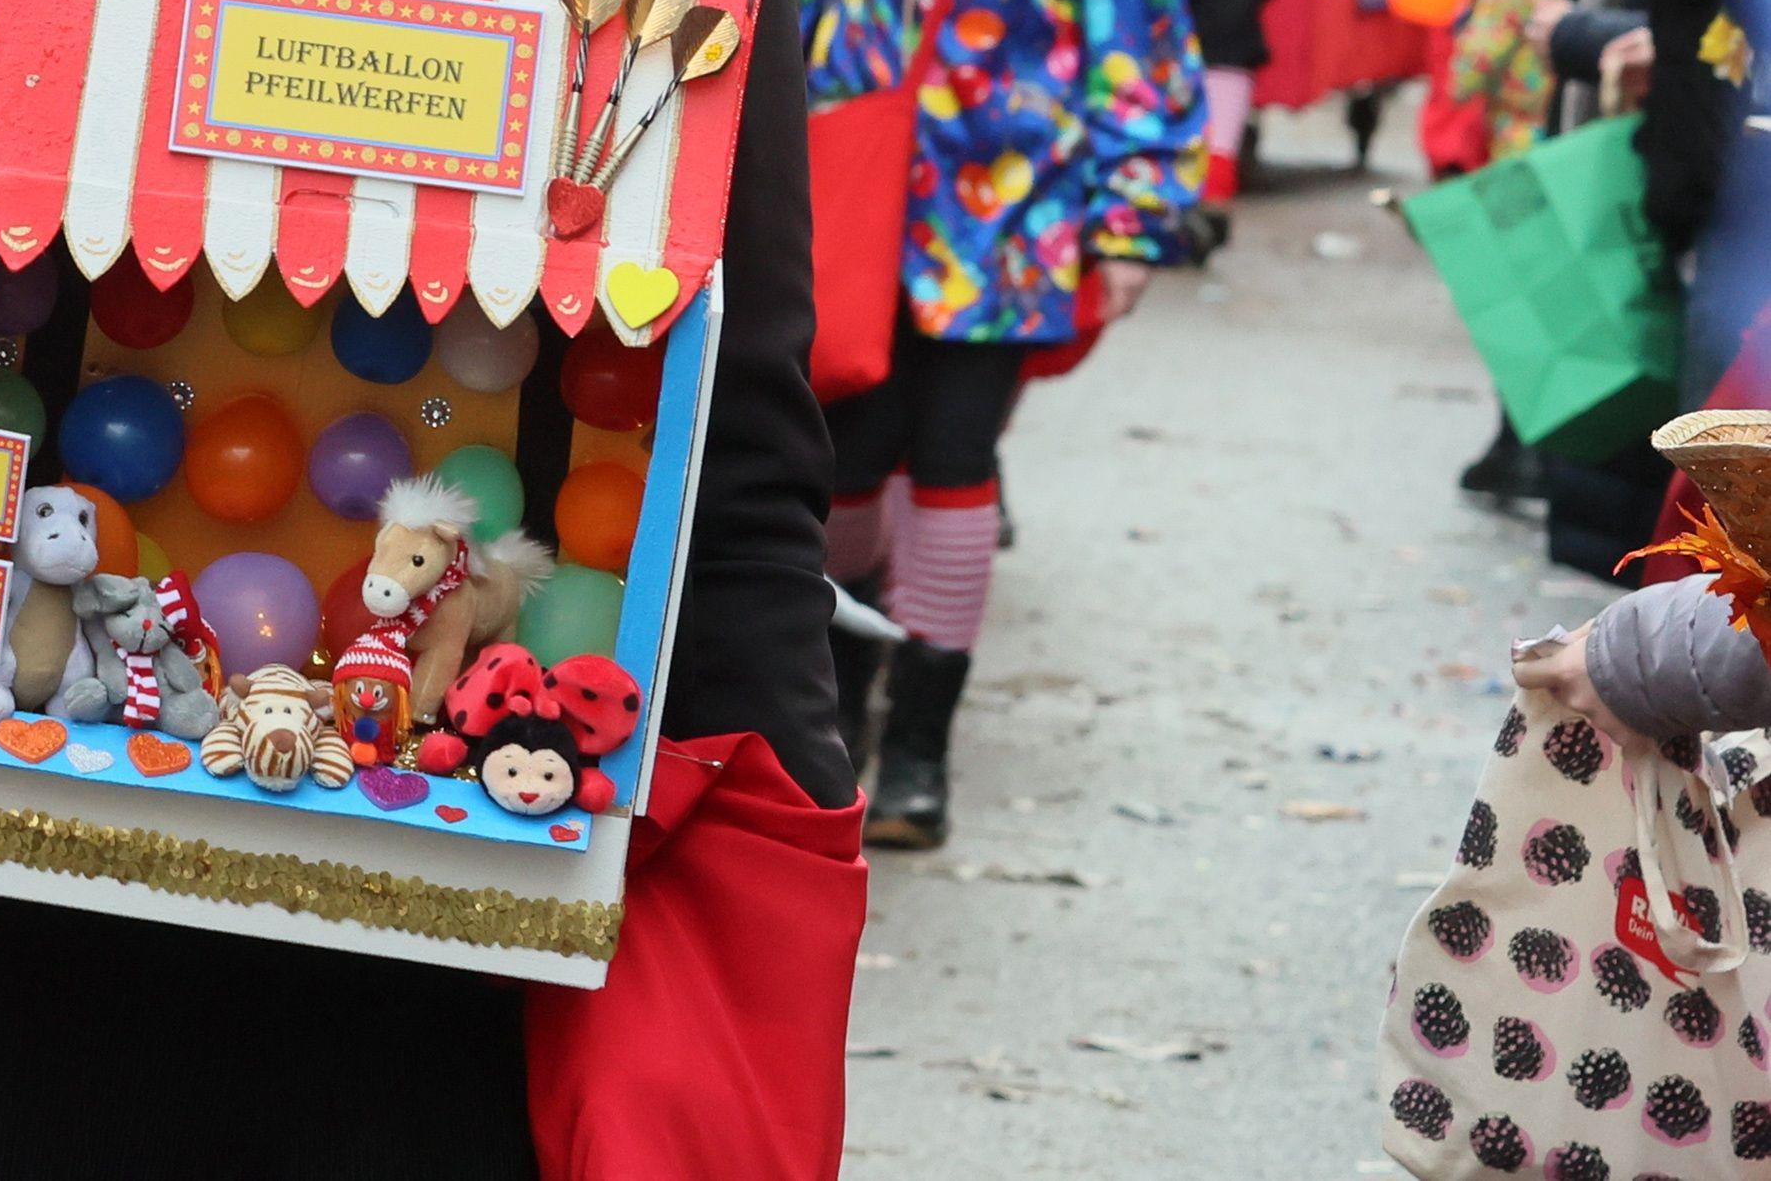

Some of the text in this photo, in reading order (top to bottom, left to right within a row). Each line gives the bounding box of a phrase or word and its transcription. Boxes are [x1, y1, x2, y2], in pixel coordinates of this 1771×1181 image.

[255, 35, 465, 85] LUFTBALLON
[245, 70, 468, 121] PFEILWERFEN
[1628, 916, 1655, 941] Dein
